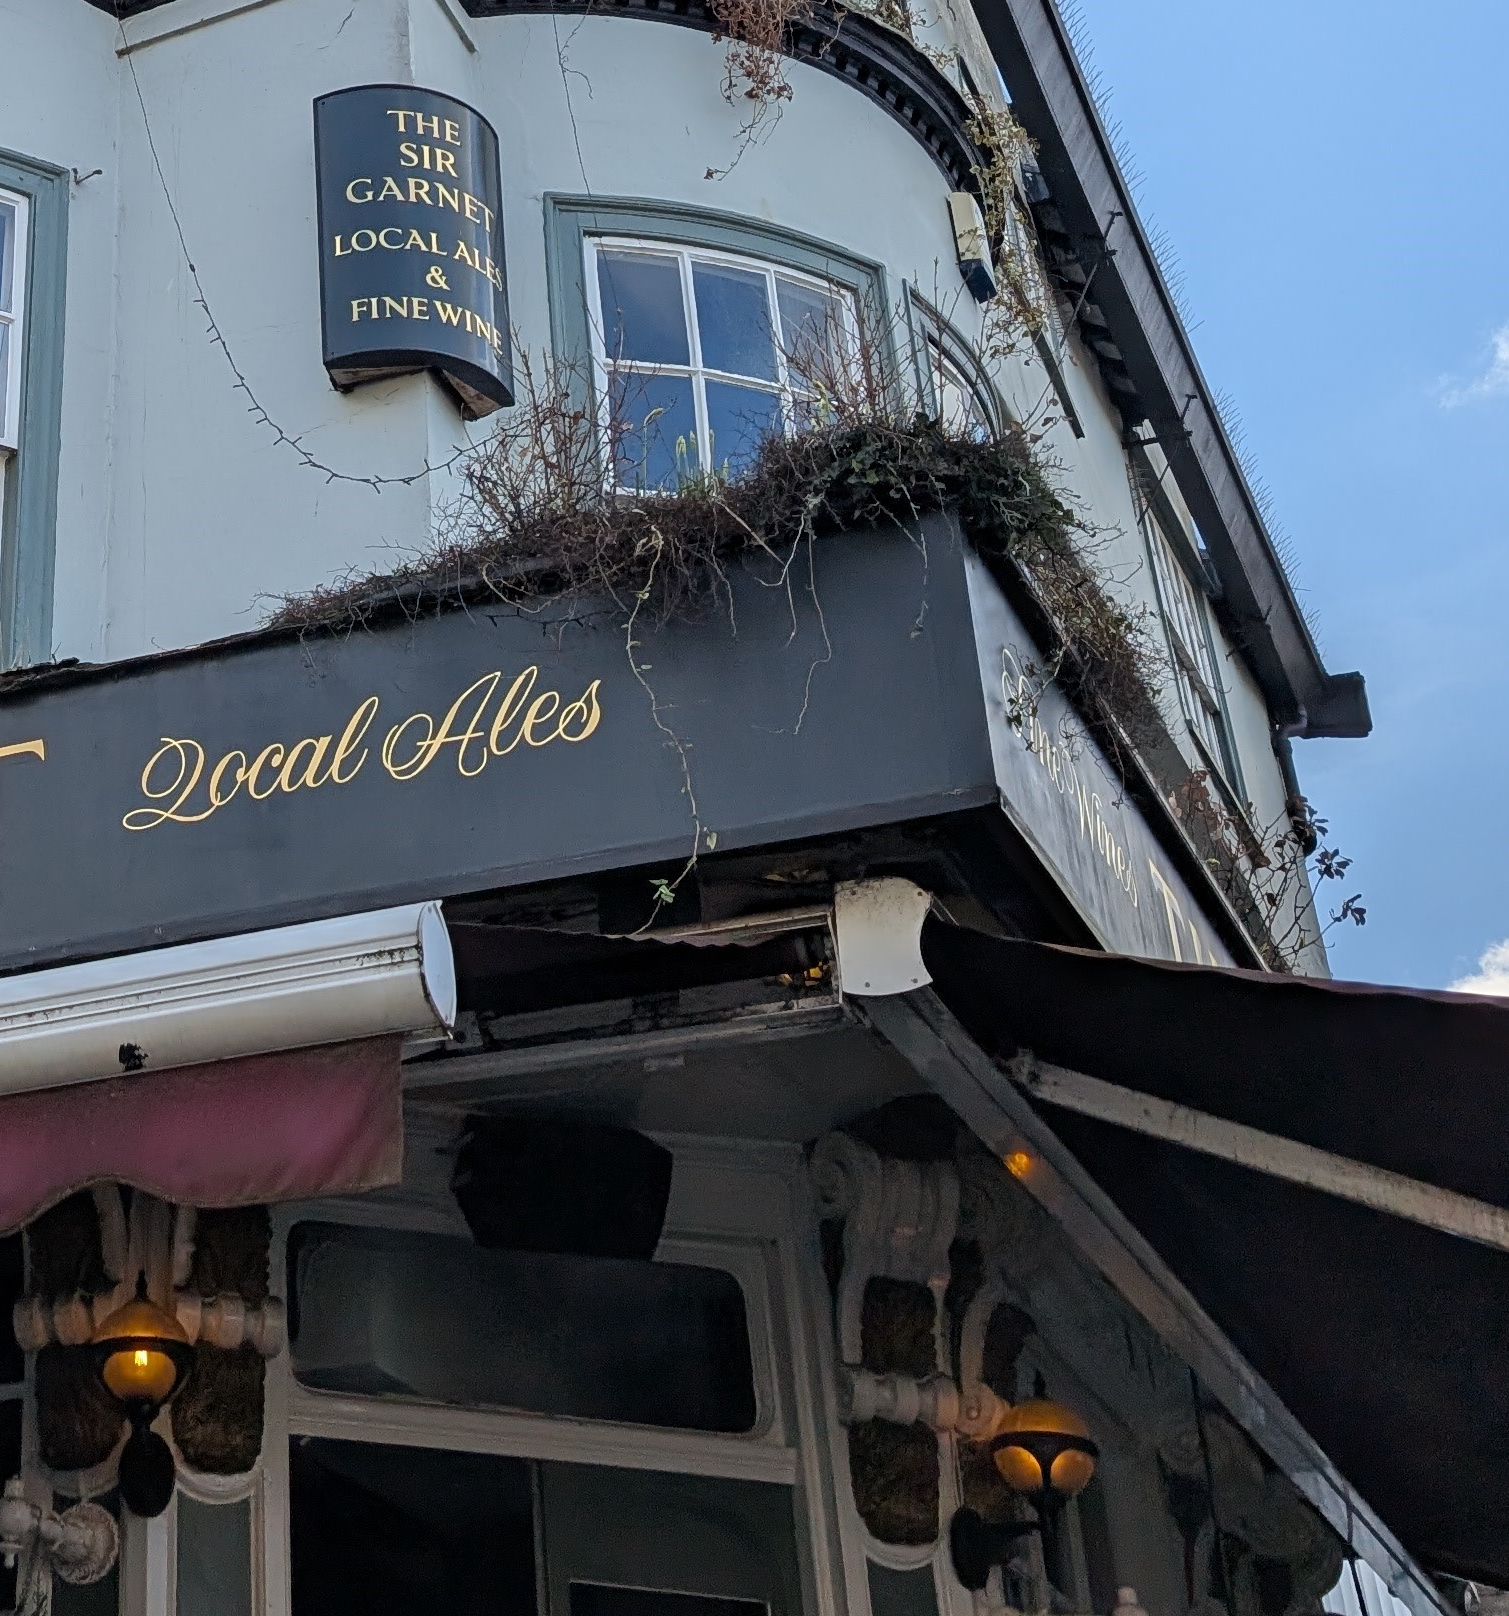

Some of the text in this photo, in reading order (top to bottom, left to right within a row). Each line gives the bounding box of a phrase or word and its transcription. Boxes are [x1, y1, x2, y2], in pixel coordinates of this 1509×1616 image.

[386, 109, 461, 146] THE
[399, 143, 459, 178] SIR
[345, 176, 495, 234] GARNET
[334, 227, 503, 292] LOCAL ALES
[425, 266, 450, 291] &
[351, 296, 503, 356] FINE WINE
[121, 665, 602, 831] Local Ales
[1059, 741, 1139, 909] Wines
